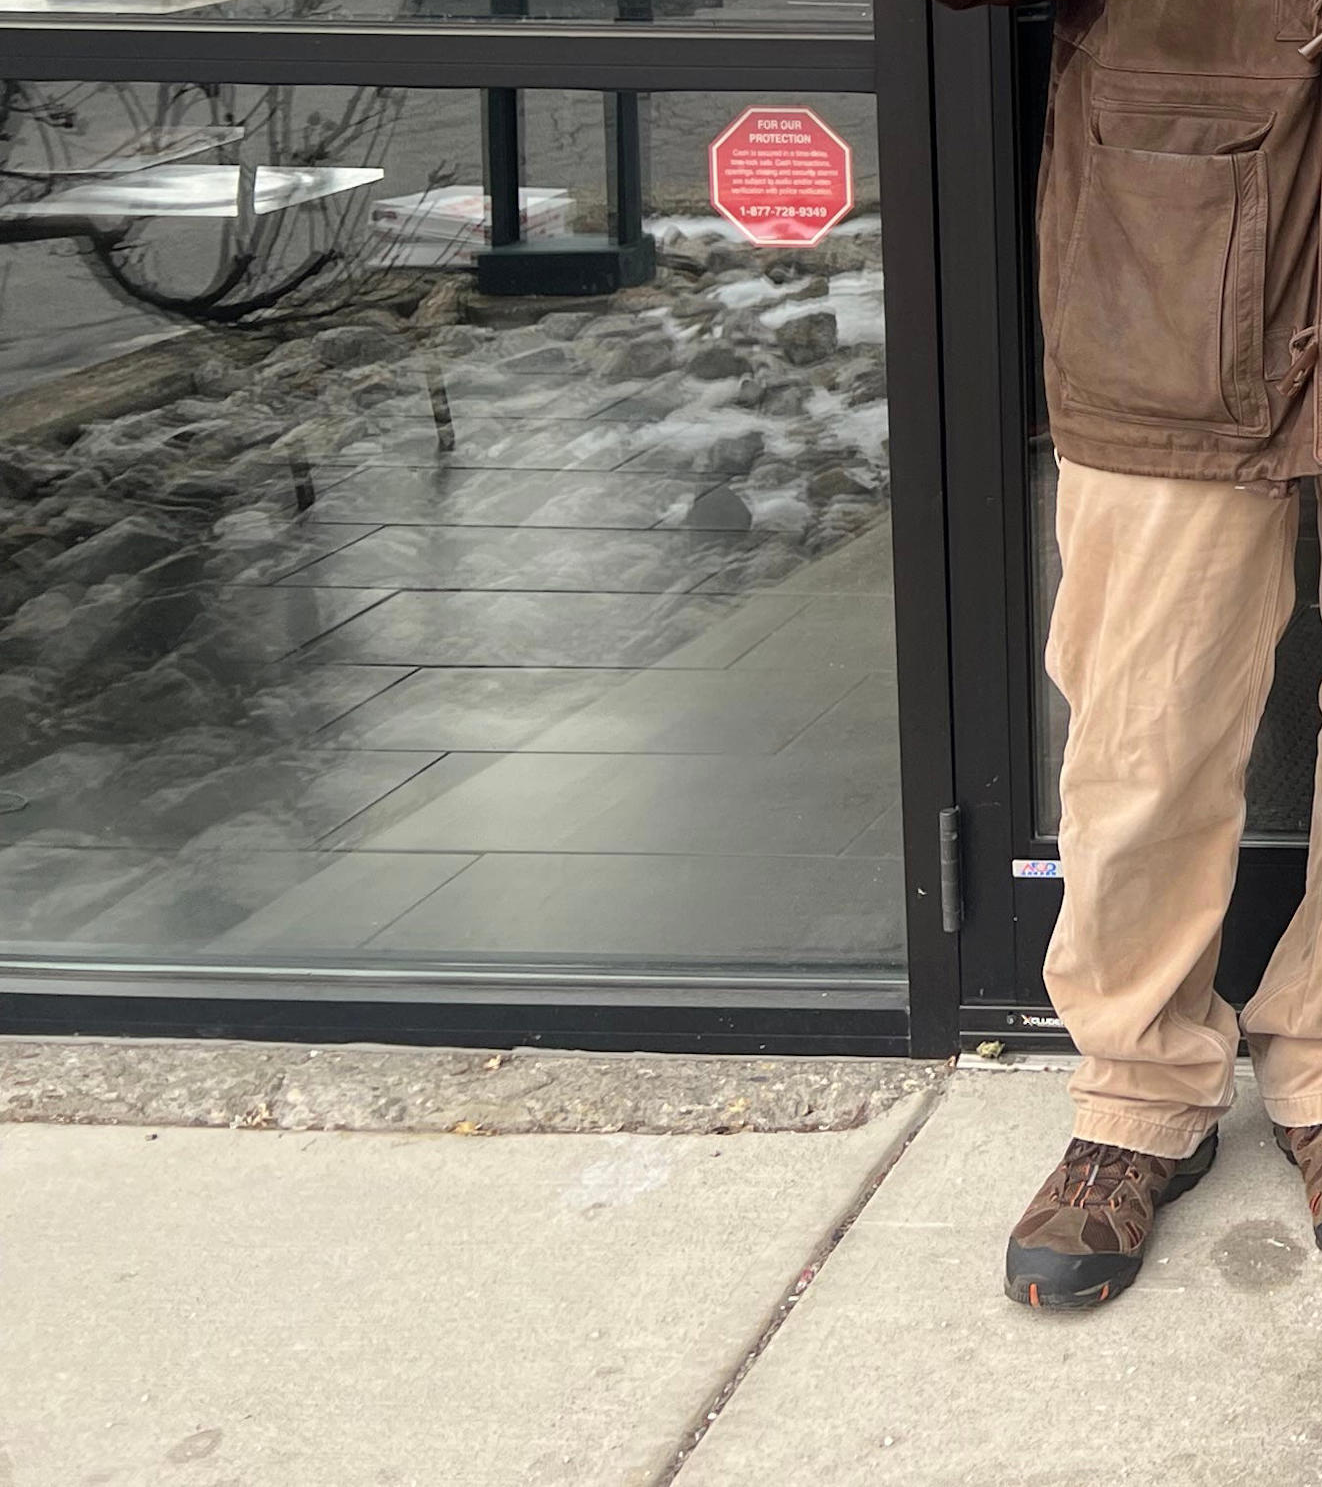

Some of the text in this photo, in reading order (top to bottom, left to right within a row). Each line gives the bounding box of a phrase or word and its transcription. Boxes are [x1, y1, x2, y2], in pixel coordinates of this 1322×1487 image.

[757, 120, 802, 130] FOR OUR
[749, 133, 811, 143] PROTECTION
[740, 205, 827, 218] 1-877-728-9349
[1021, 1014, 1064, 1027] XCLUDE
